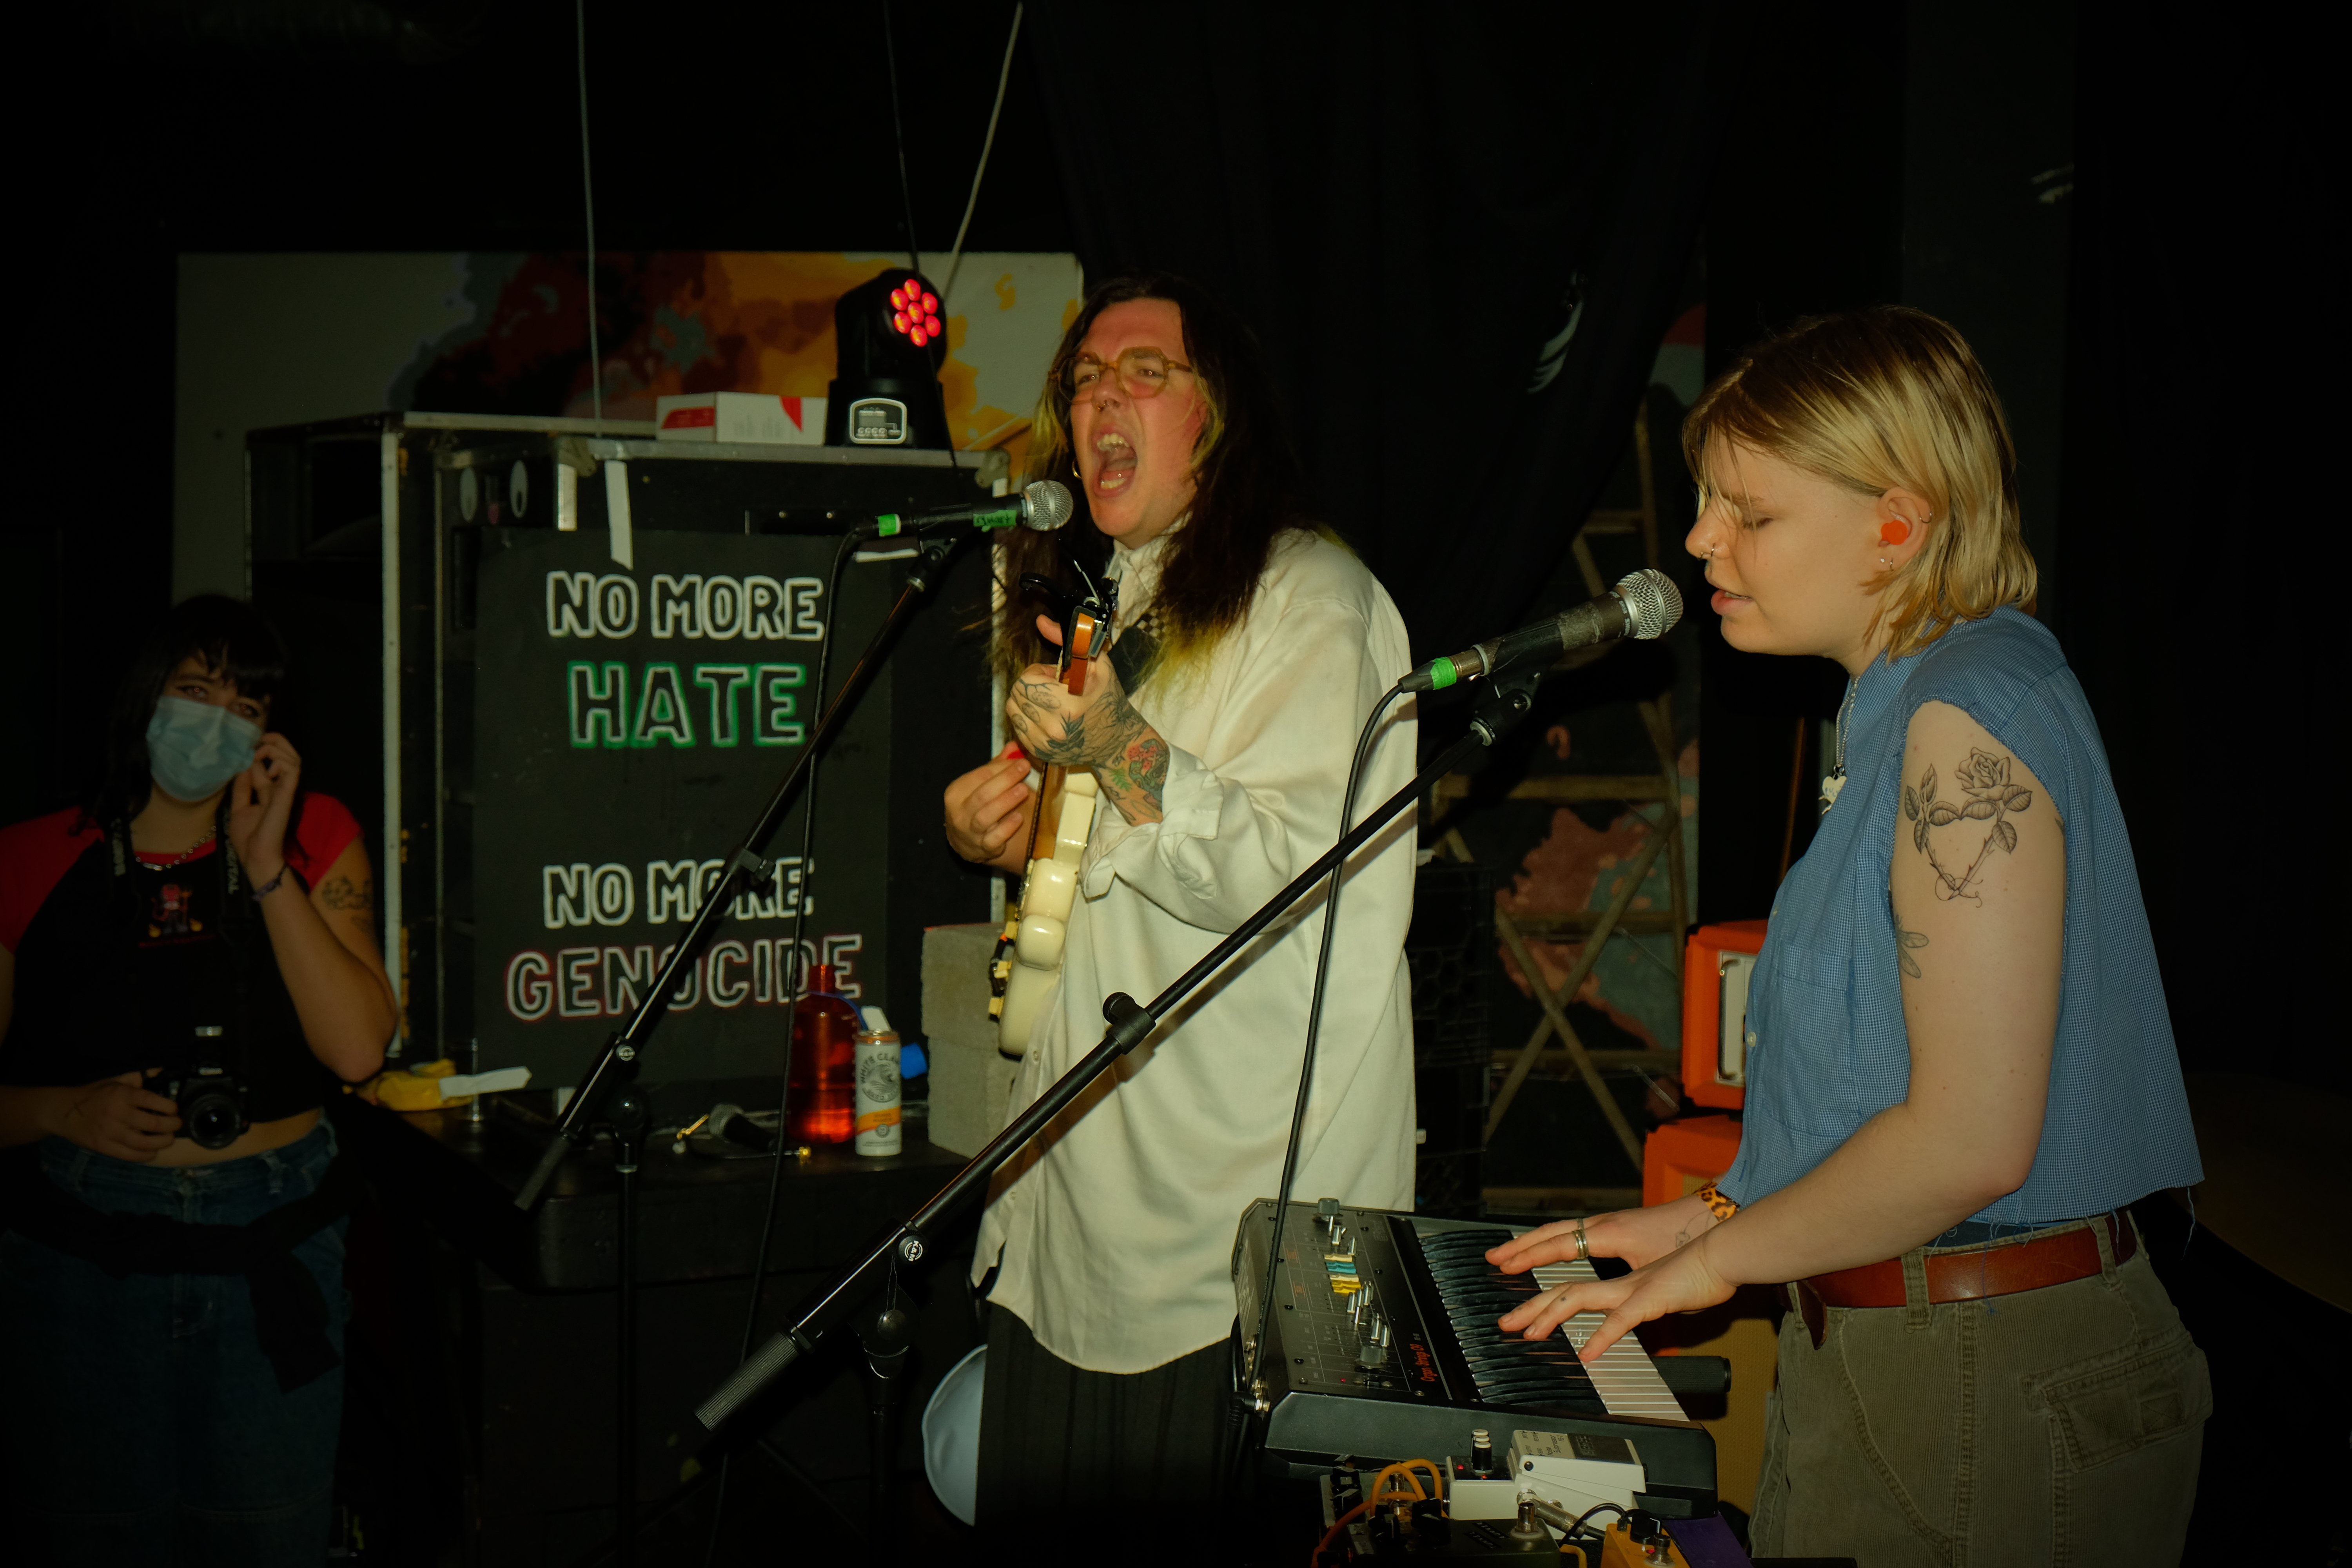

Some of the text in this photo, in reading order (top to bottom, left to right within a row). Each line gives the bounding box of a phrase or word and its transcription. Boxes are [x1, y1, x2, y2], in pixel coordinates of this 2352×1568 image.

[547, 571, 825, 642] NO MORE
[567, 661, 806, 748] HATE
[543, 862, 635, 929] NO
